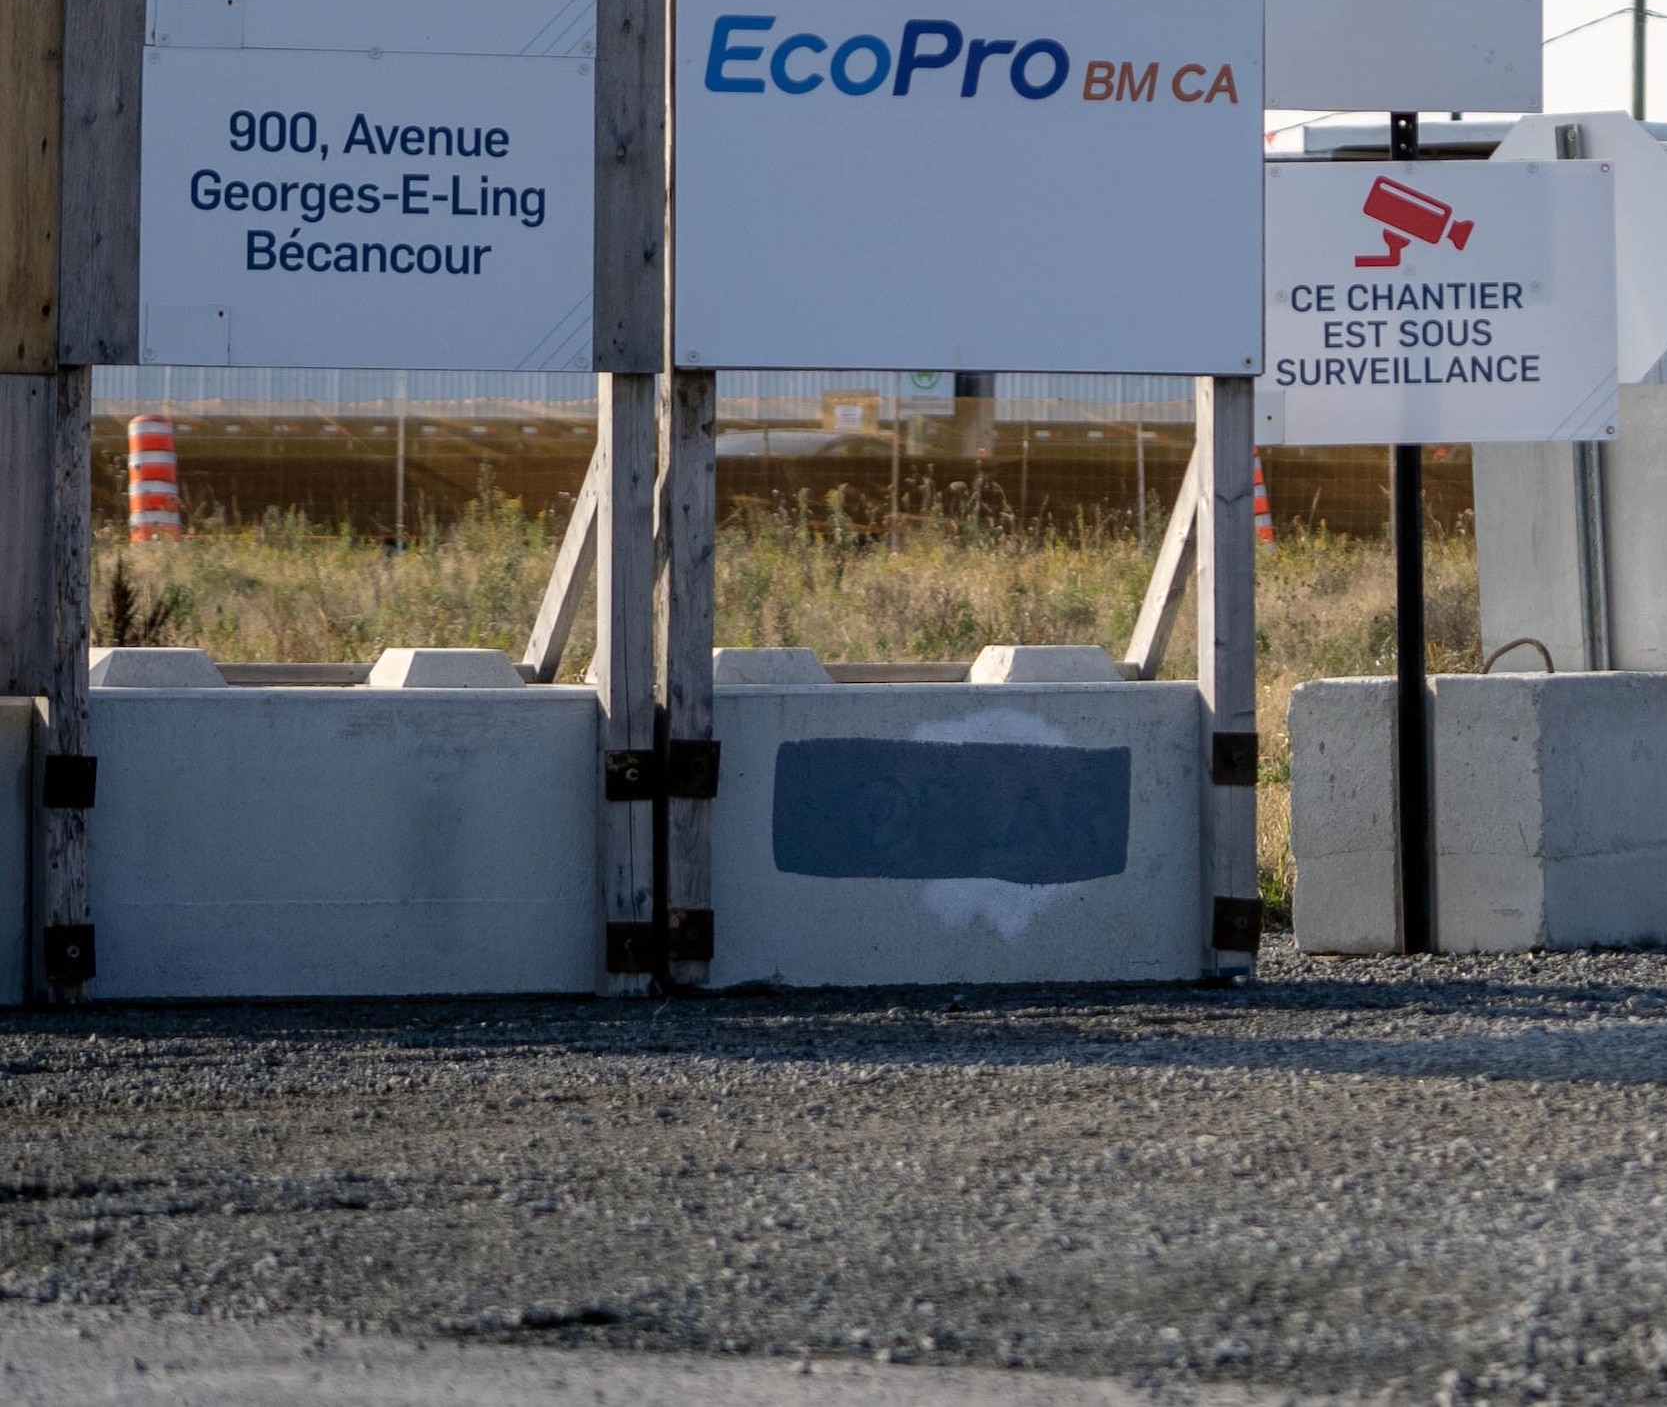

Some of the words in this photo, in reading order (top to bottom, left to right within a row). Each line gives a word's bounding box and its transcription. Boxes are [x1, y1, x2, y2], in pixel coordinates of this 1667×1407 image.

[704, 14, 1070, 100] EcoPro
[1082, 60, 1159, 102] BM
[1171, 63, 1239, 104] CA
[228, 110, 329, 162] 900,
[343, 113, 510, 158] Avenue
[190, 169, 547, 227] Georges-E-Ling
[246, 226, 491, 276] Bécancour
[1291, 284, 1335, 312] CE
[1346, 282, 1524, 311] CHANTIER
[1323, 321, 1383, 349] EST
[1398, 319, 1493, 347] SOUS
[1276, 354, 1541, 387] SURVEILLANCE
